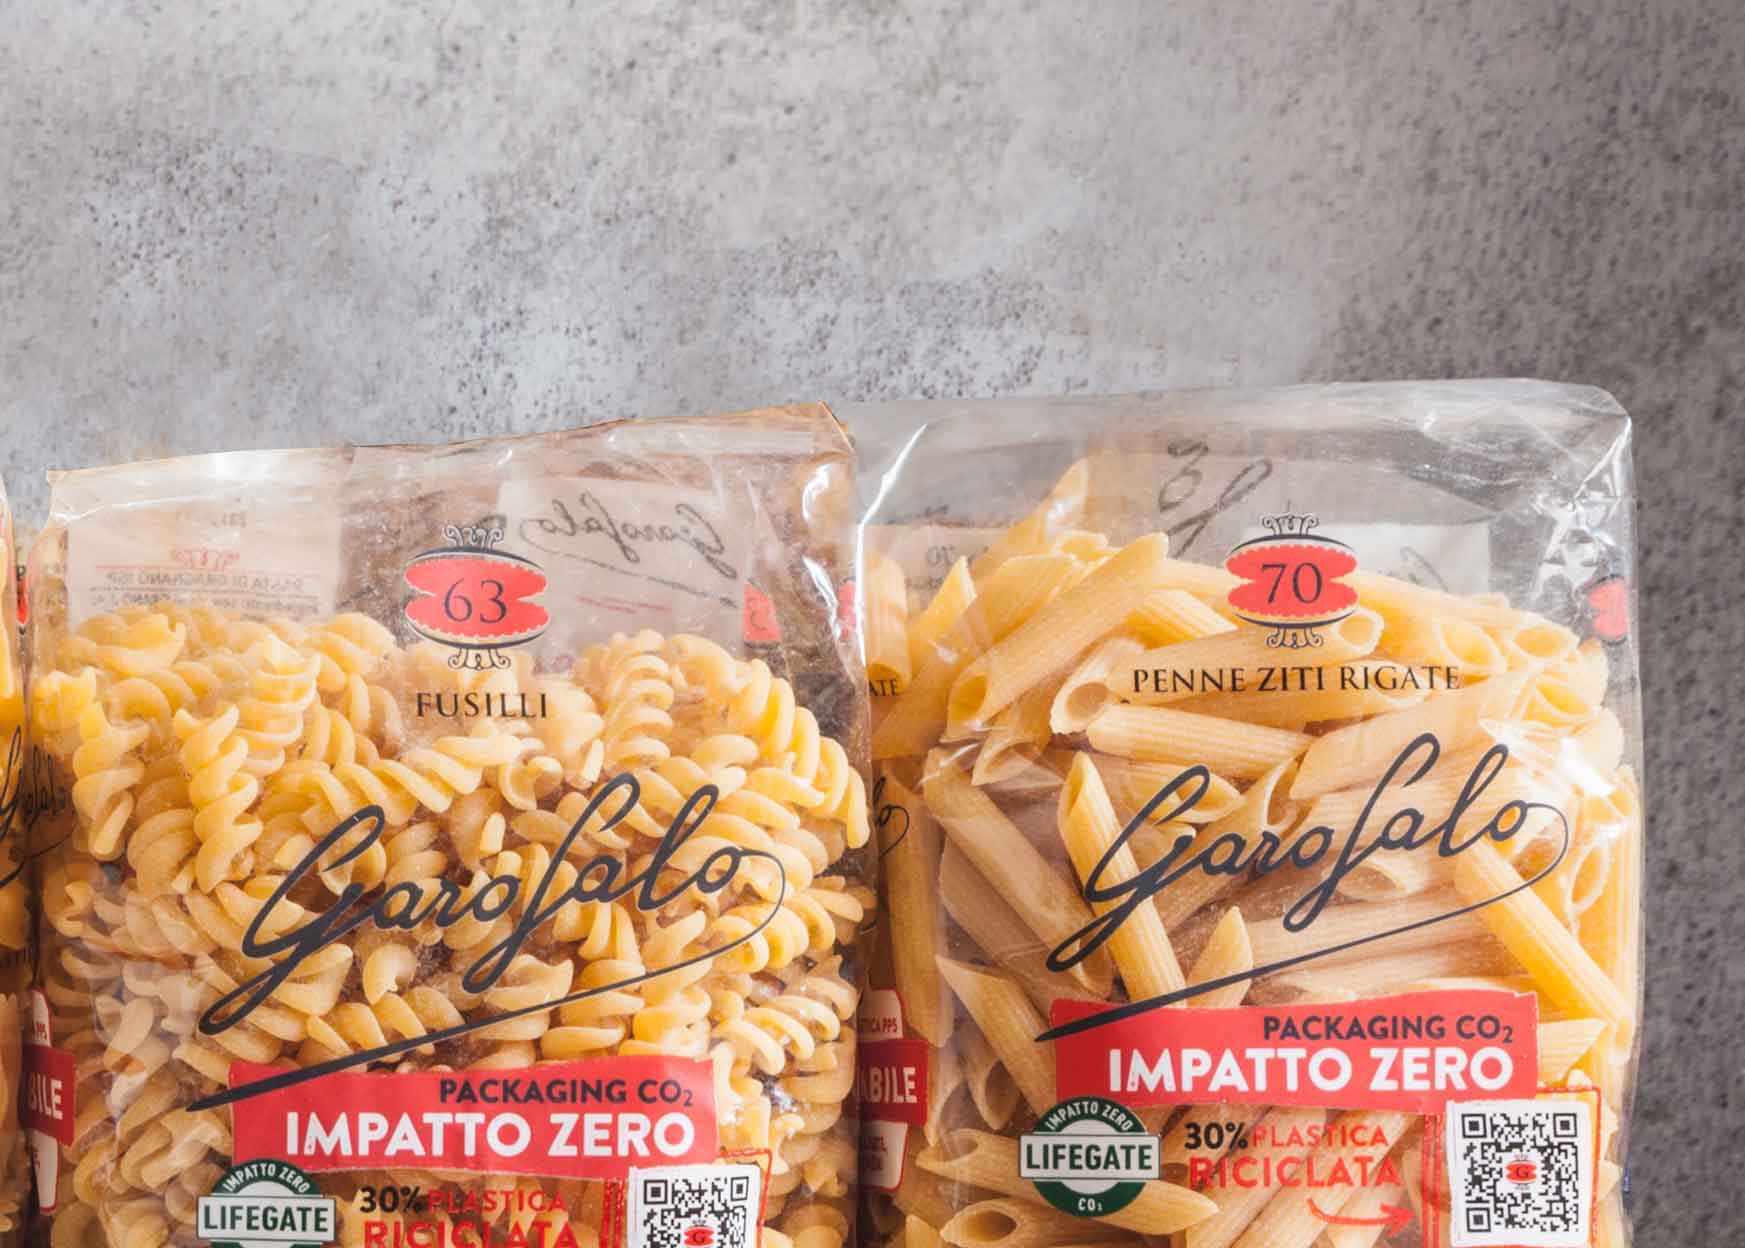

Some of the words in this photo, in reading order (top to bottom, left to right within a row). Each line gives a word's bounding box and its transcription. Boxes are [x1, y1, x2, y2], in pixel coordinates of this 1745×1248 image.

[1259, 561, 1324, 605] 70
[443, 577, 508, 624] 63
[1132, 667, 1245, 694] PENNE
[1257, 666, 1325, 693] ZITI
[1339, 664, 1460, 692] RIGATE
[416, 691, 547, 719] FUSILLI
[1046, 733, 1568, 972] Garofalo
[198, 773, 786, 1035] Garofalo
[1263, 1015, 1450, 1041] PACKAGING
[1109, 1047, 1353, 1093] IMPATTO
[1369, 1047, 1514, 1092] ZERO
[439, 1078, 627, 1105] PACKAGING
[1044, 1101, 1099, 1131] IMPATTO
[1101, 1104, 1134, 1131] ZERO
[286, 1111, 532, 1157] IMPATTO
[547, 1111, 696, 1158] ZERO
[1184, 1121, 1249, 1151] 30%
[1252, 1124, 1389, 1148] PLASTICA
[1026, 1143, 1153, 1170] LIFEGATE
[1189, 1154, 1402, 1189] RICICLATA
[222, 1163, 276, 1192] IMPATTO
[279, 1167, 311, 1193] ZERO
[359, 1185, 425, 1214] 30%
[427, 1190, 567, 1213] PLASTICA
[203, 1204, 329, 1233] LIFEGATE
